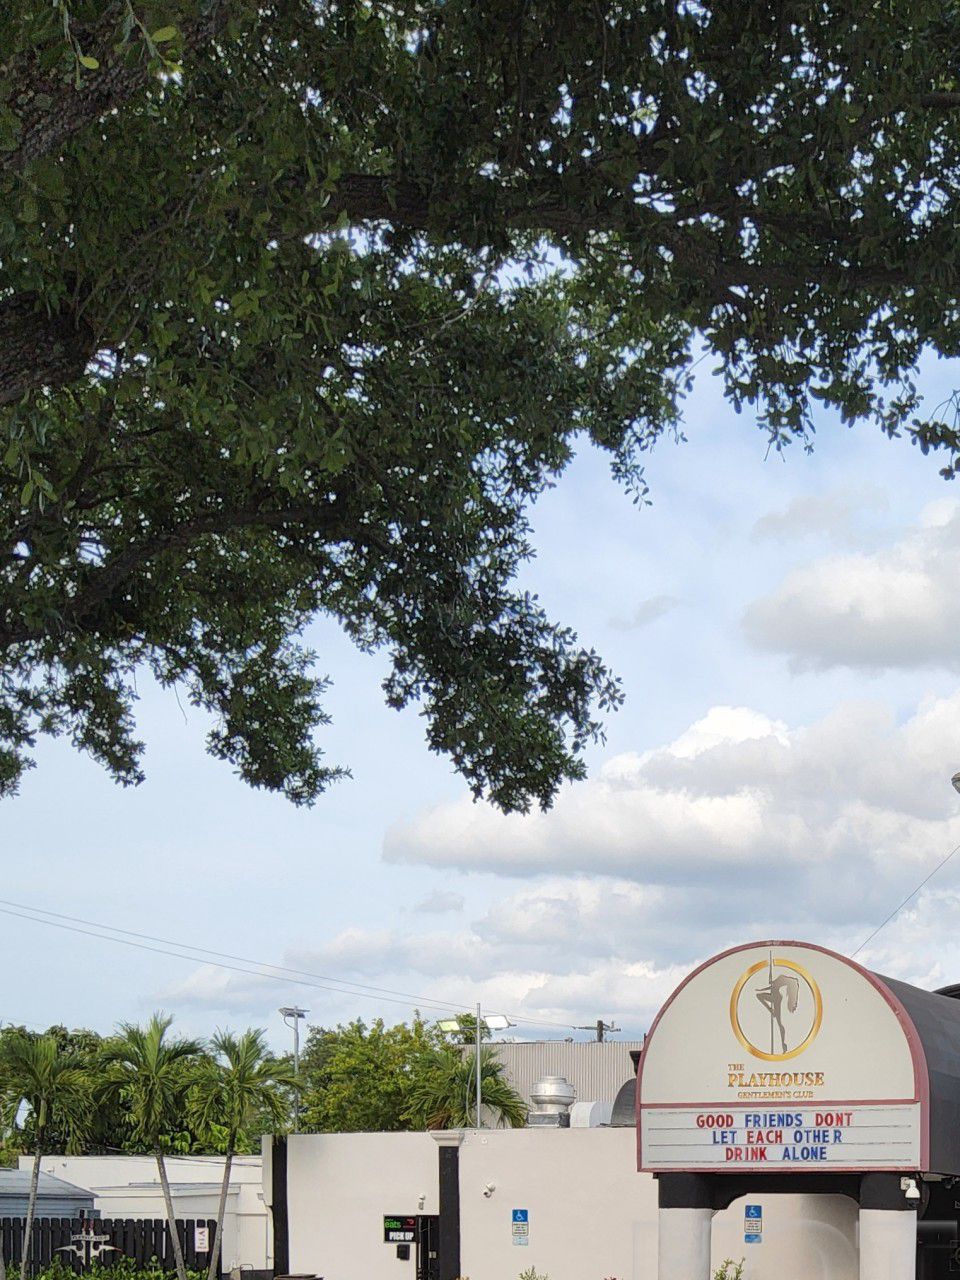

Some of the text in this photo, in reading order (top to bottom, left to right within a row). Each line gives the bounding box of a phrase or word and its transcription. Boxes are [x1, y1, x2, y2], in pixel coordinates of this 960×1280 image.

[727, 1072, 825, 1088] PLAYHOUSE
[792, 1091, 814, 1099] CLUB
[696, 1112, 853, 1128] GOOD FRIENDS DONT
[712, 1130, 843, 1145] LET EACH OTHER
[725, 1146, 828, 1161] DRINK ALONE
[388, 1231, 414, 1241] PICK UP
